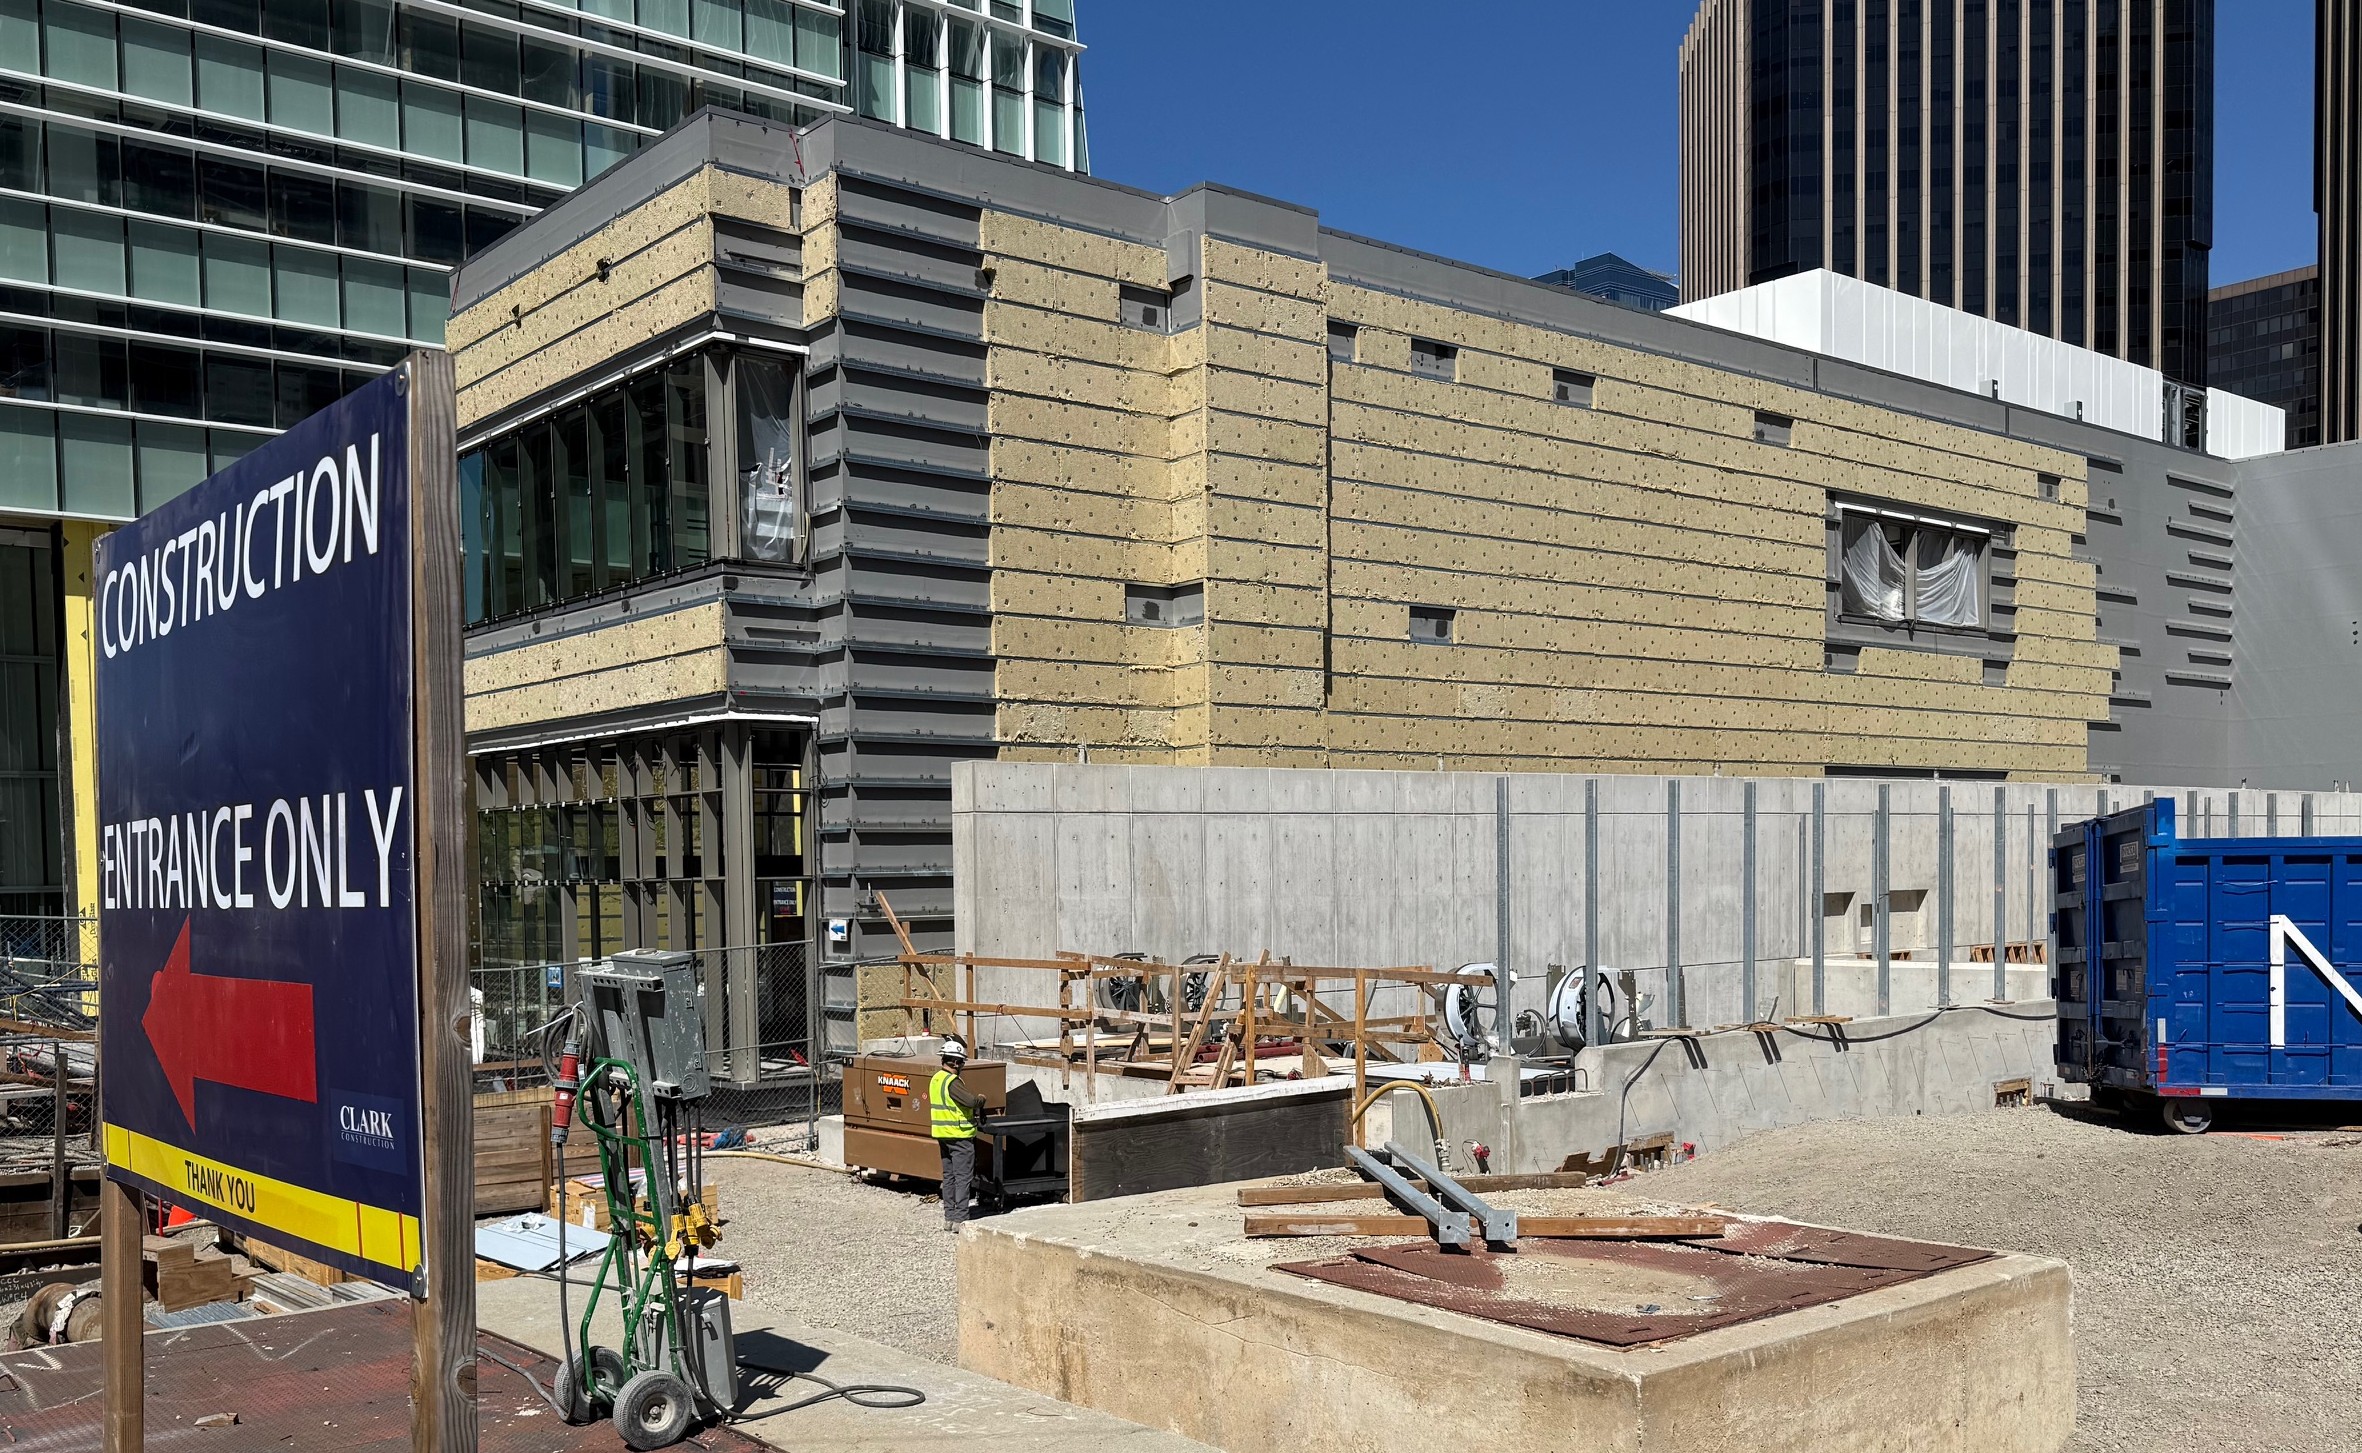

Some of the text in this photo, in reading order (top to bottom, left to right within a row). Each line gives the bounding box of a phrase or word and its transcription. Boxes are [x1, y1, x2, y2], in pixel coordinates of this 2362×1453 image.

[102, 432, 380, 659] CONSTRUCTION
[104, 786, 404, 910] ENTRANCE ONLY
[2270, 914, 2362, 1050] N
[878, 1075, 910, 1088] KNAACK
[340, 1105, 394, 1138] CLARK
[341, 1132, 395, 1150] CONSTRUCTION
[184, 1159, 255, 1214] THANK YOU
